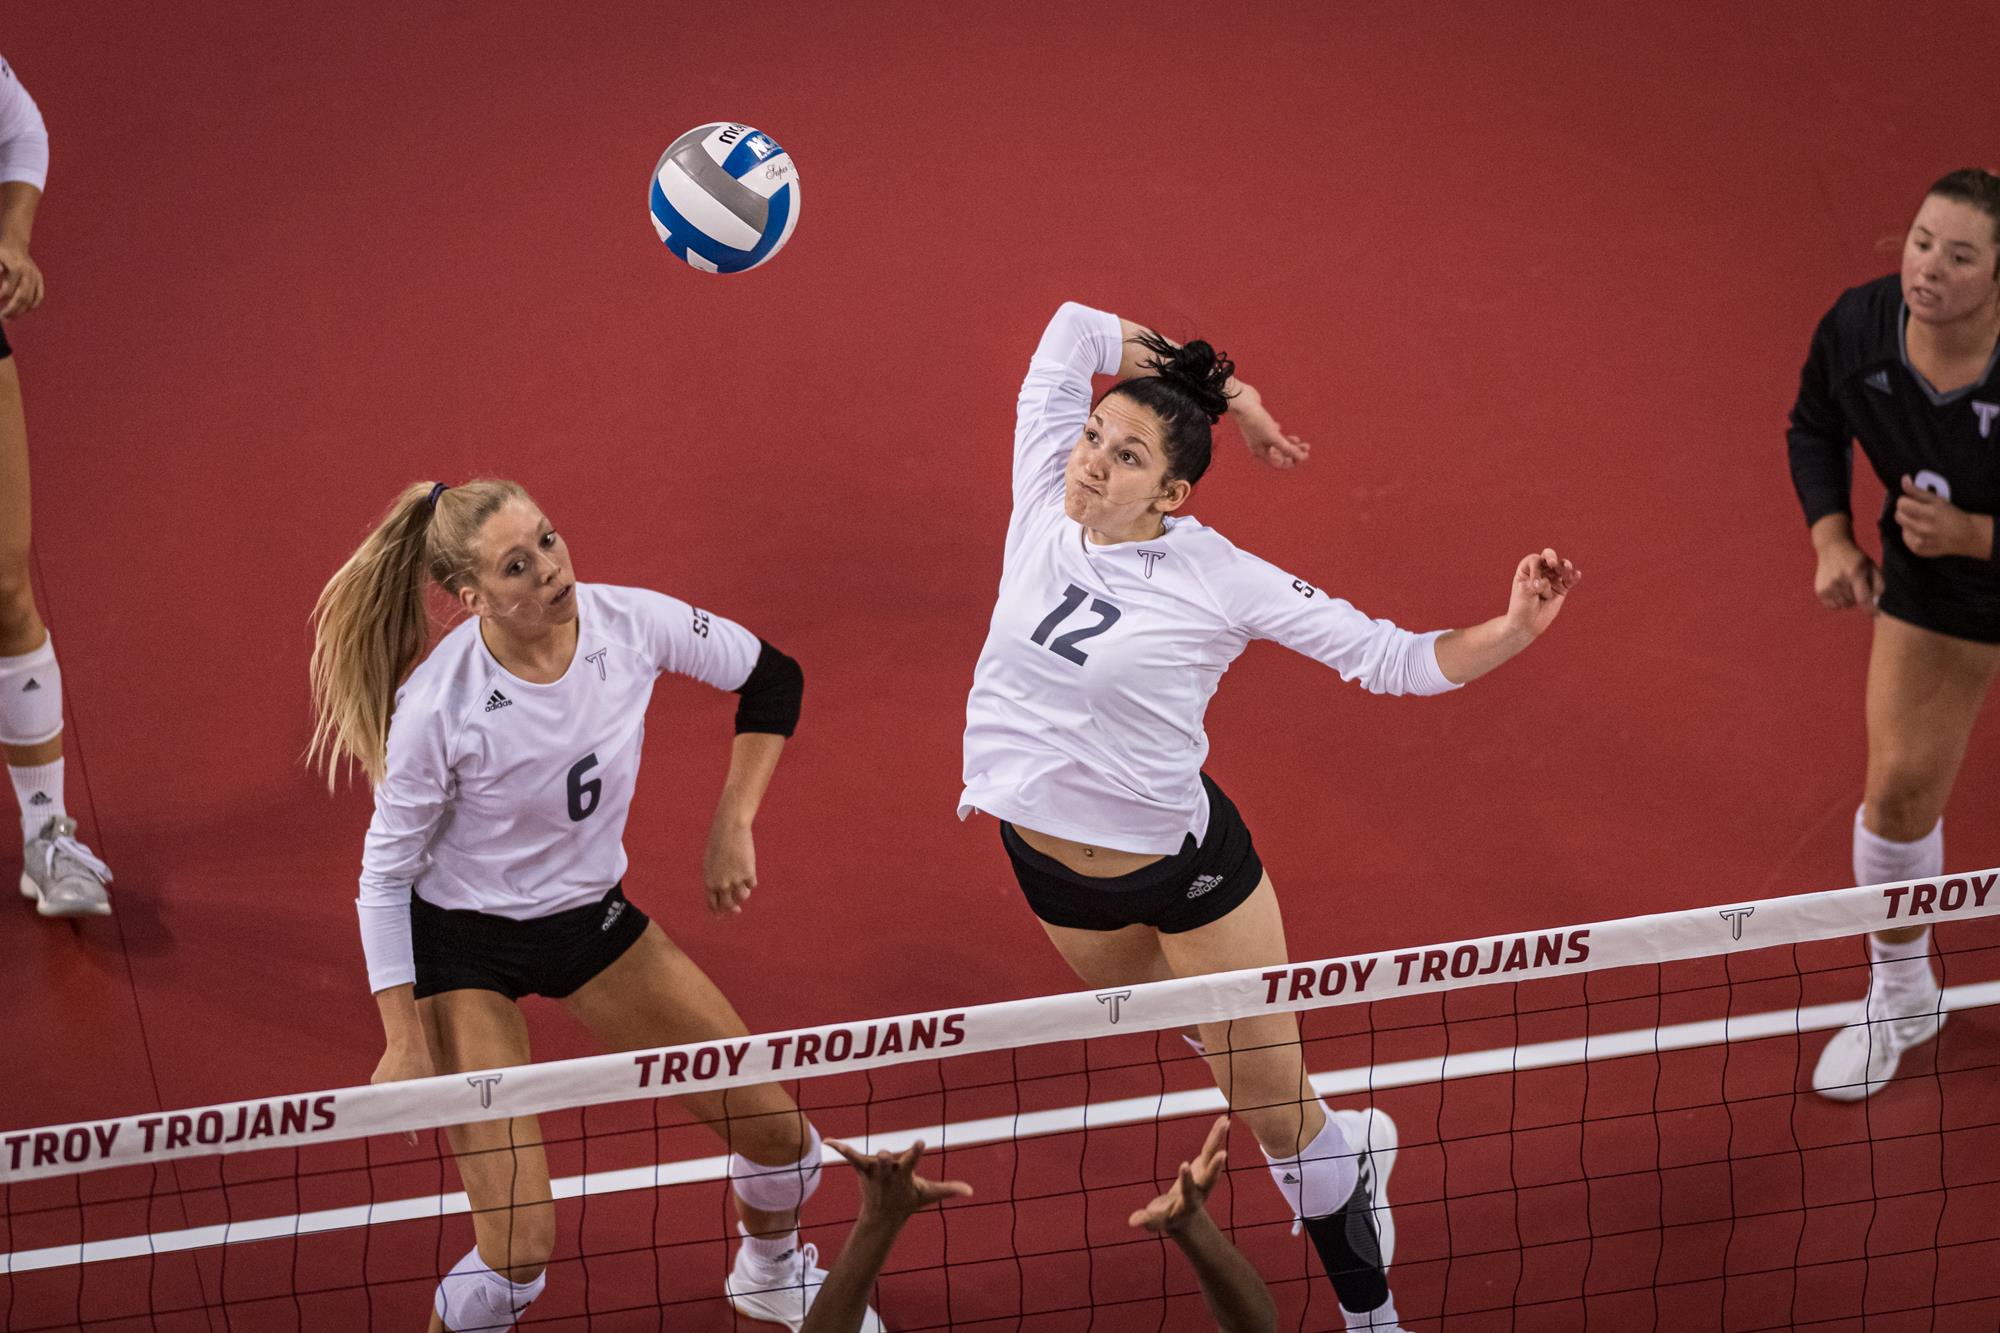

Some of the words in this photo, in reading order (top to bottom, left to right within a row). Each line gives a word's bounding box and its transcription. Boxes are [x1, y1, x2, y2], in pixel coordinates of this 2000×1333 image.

[1030, 583, 1122, 667] 12
[484, 699, 513, 713] adidas
[566, 752, 602, 822] 6
[1186, 874, 1224, 899] adidas
[1883, 873, 2000, 919] TROY
[1262, 957, 1378, 1004] TROY
[1394, 930, 1591, 987] TROJANS
[633, 1042, 751, 1088] TROY
[767, 1013, 966, 1070] TROJANS
[4, 1123, 121, 1170] TROY
[137, 1095, 336, 1153] TROJANS
